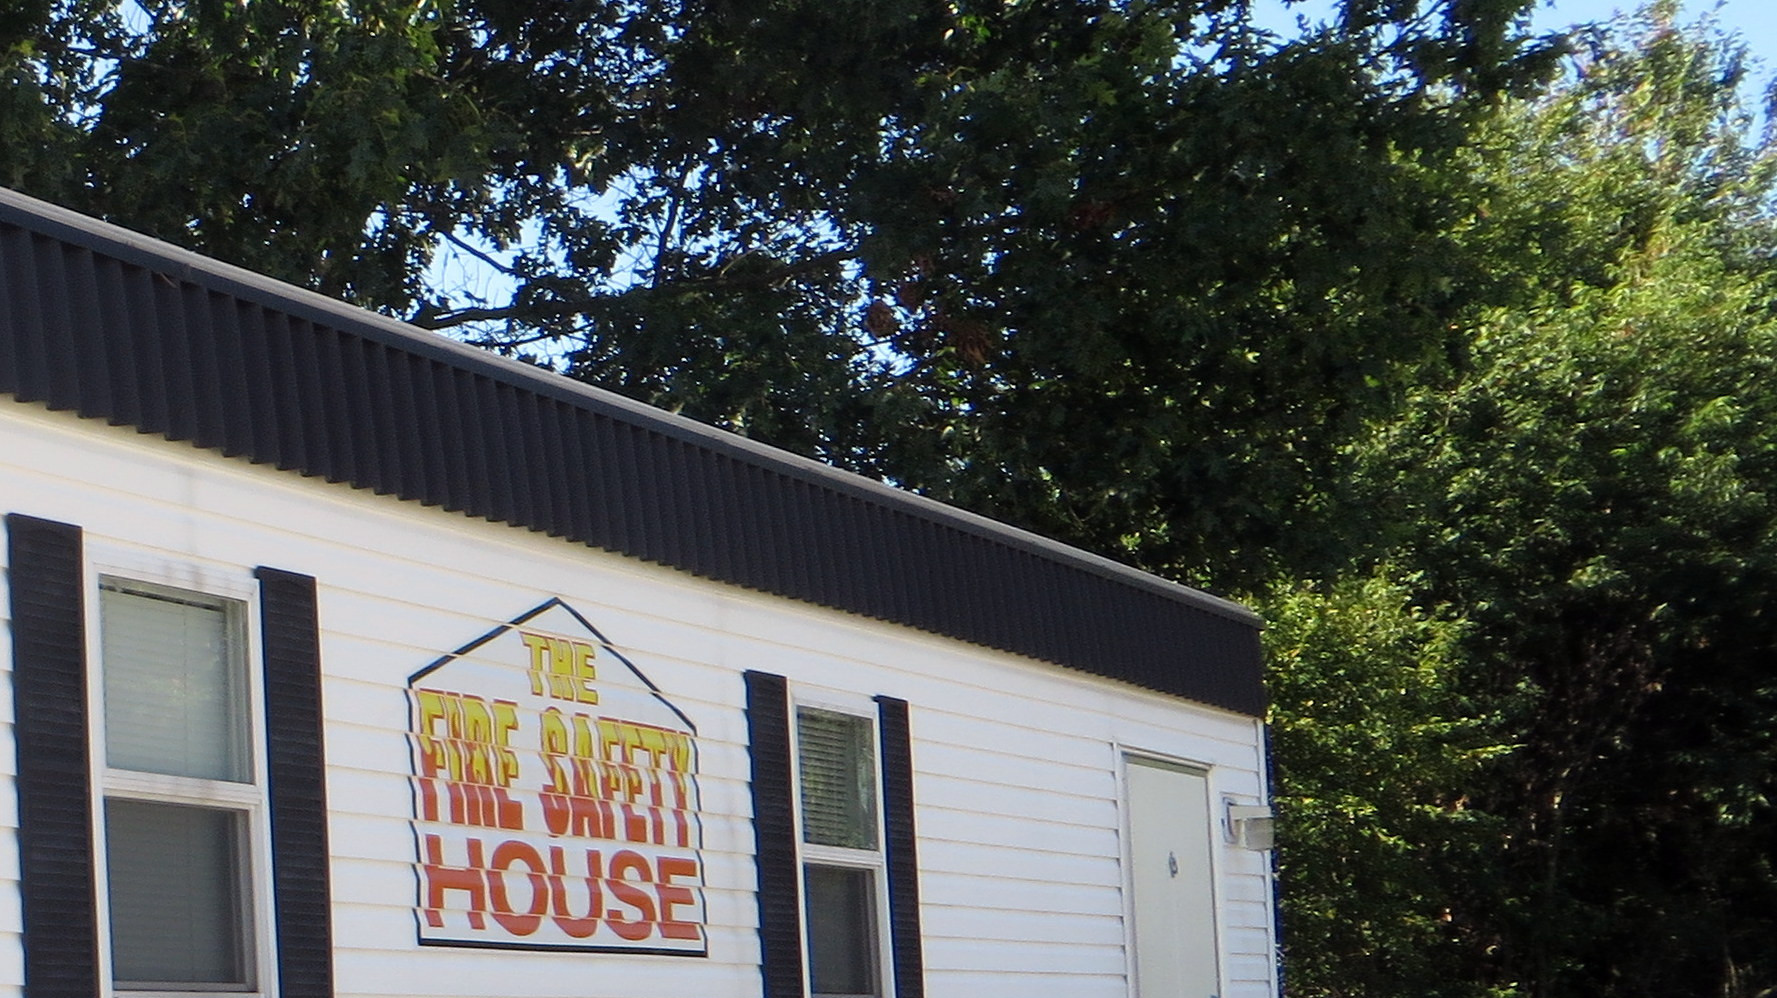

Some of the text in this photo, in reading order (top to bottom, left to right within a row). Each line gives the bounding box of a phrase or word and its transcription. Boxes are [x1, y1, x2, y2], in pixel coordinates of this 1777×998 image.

[520, 631, 599, 705] THE
[419, 687, 691, 848] FIRE SAFETY
[424, 833, 701, 942] HOUSE
